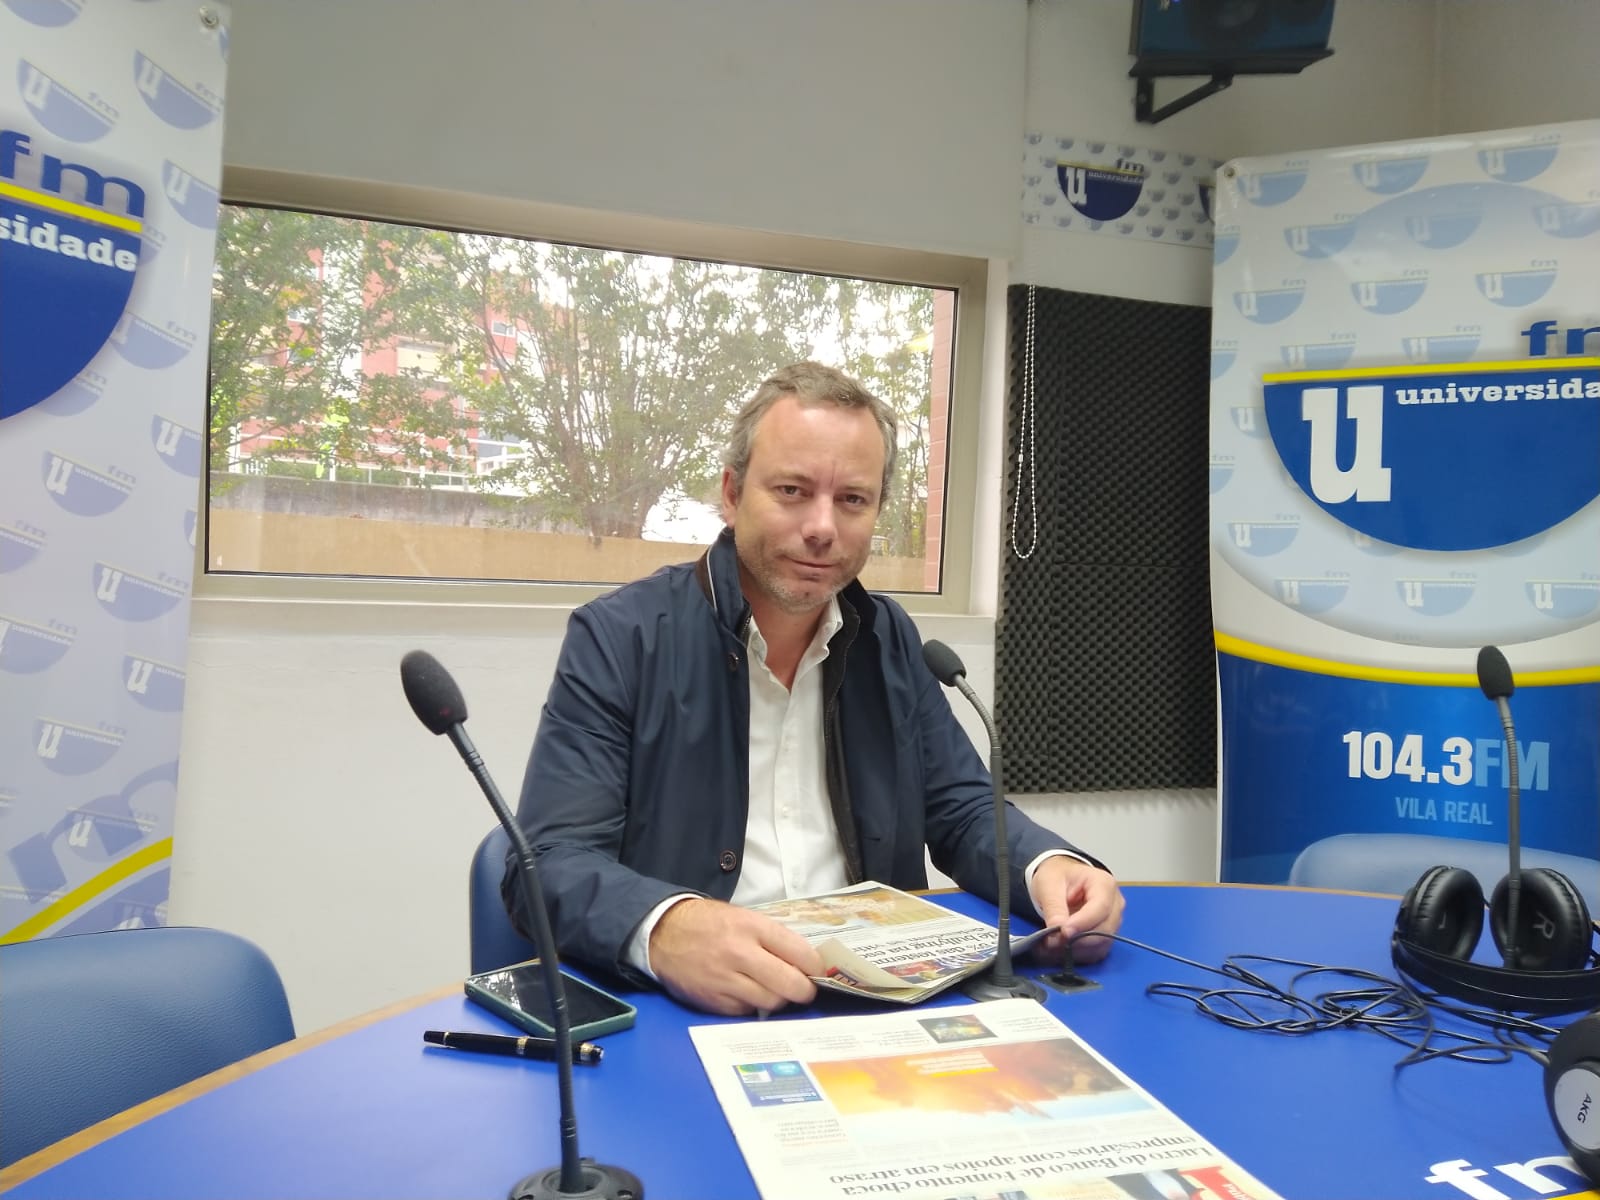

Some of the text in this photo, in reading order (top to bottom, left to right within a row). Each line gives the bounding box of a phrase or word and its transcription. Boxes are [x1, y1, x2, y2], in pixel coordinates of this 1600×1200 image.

[0, 129, 145, 218] fm
[1066, 167, 1087, 205] u
[0, 214, 137, 272] sidade
[1303, 378, 1600, 504] u universida
[1395, 796, 1493, 826] VILA REAL
[911, 934, 980, 950] bullying
[1577, 1092, 1592, 1124] AKG
[841, 1146, 1213, 1196] Lucro do Banco de Fomento choca
[903, 1164, 941, 1176] em
[942, 1155, 1017, 1172] apoios
[1020, 1149, 1066, 1164] com
[829, 1169, 902, 1185] atraso
